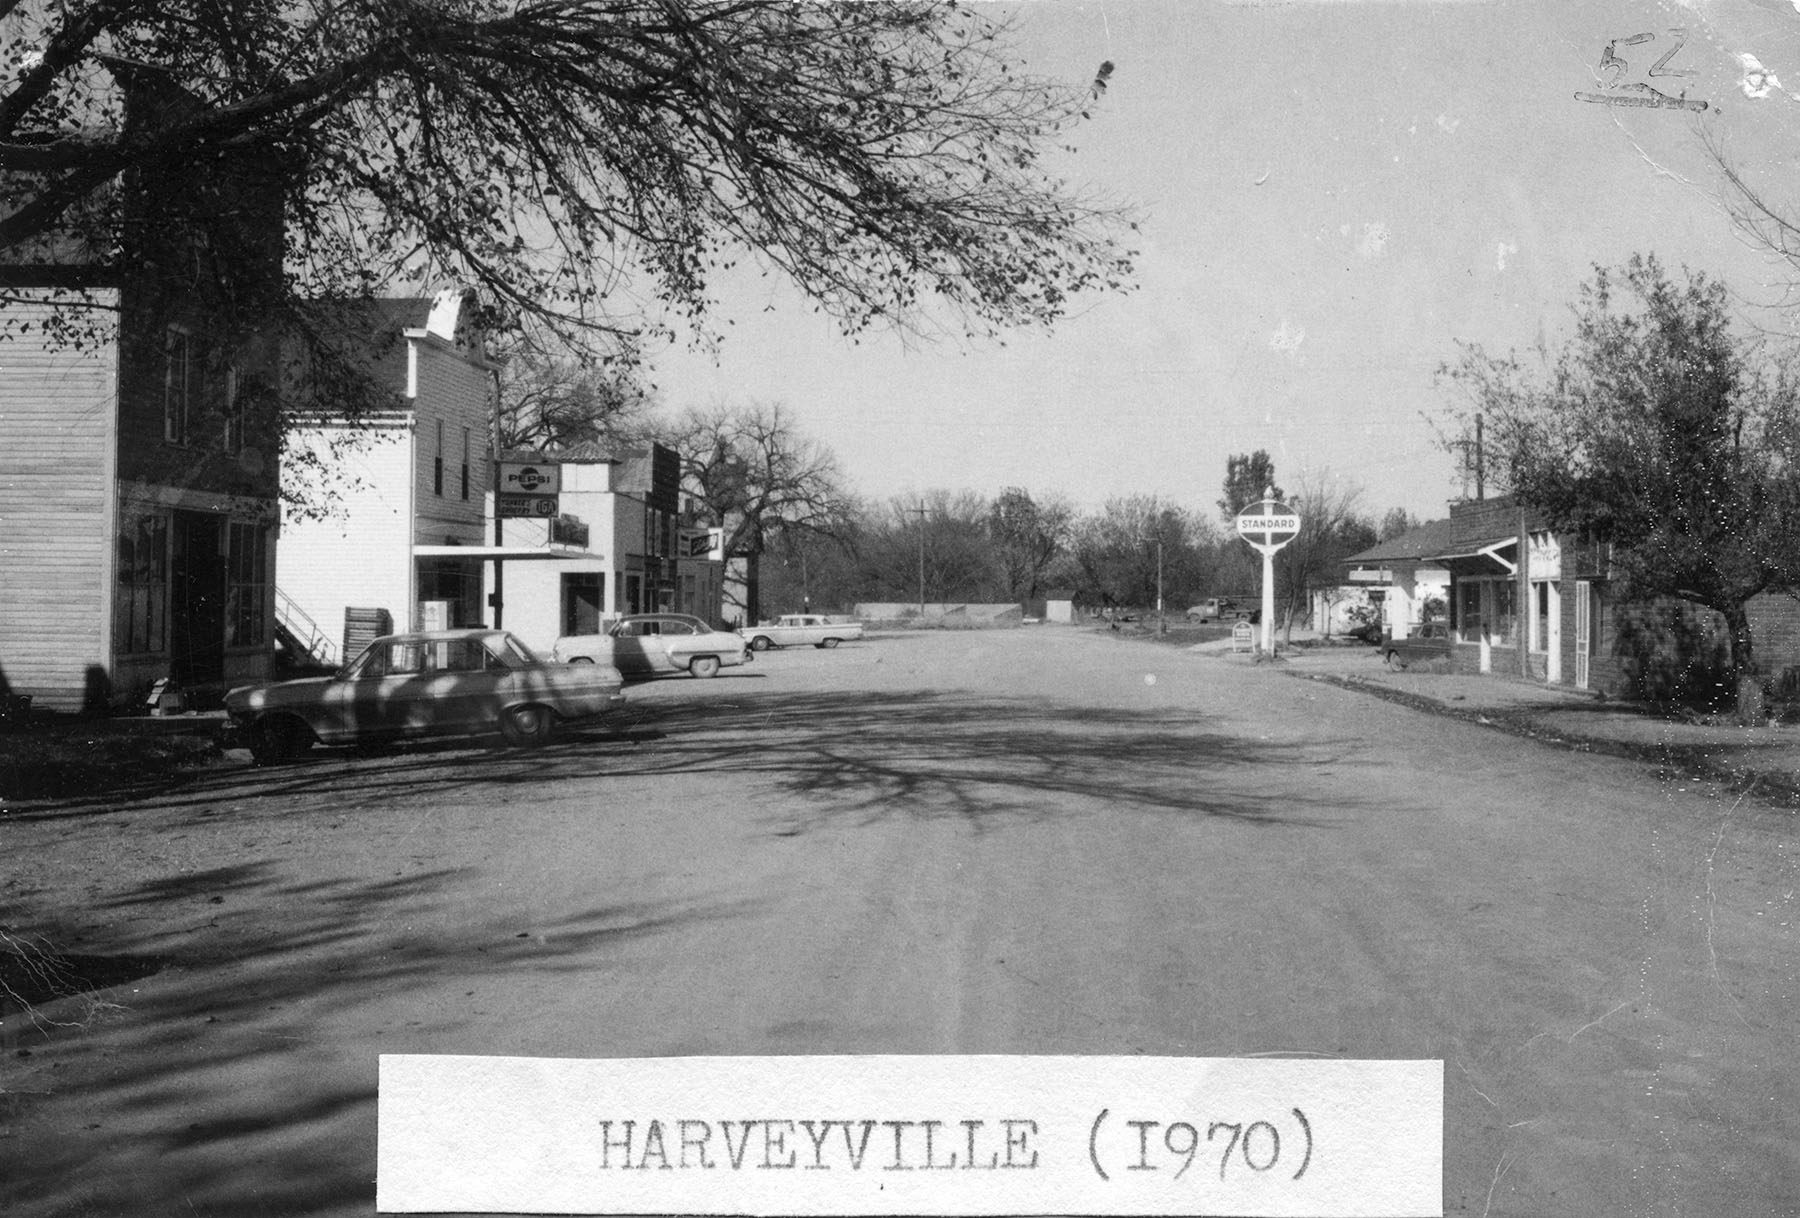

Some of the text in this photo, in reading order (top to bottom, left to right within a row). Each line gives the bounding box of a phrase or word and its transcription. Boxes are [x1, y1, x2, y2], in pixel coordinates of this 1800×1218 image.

[508, 474, 550, 483] PEPSI
[537, 500, 555, 513] IGA
[1241, 519, 1295, 528] STANDARD
